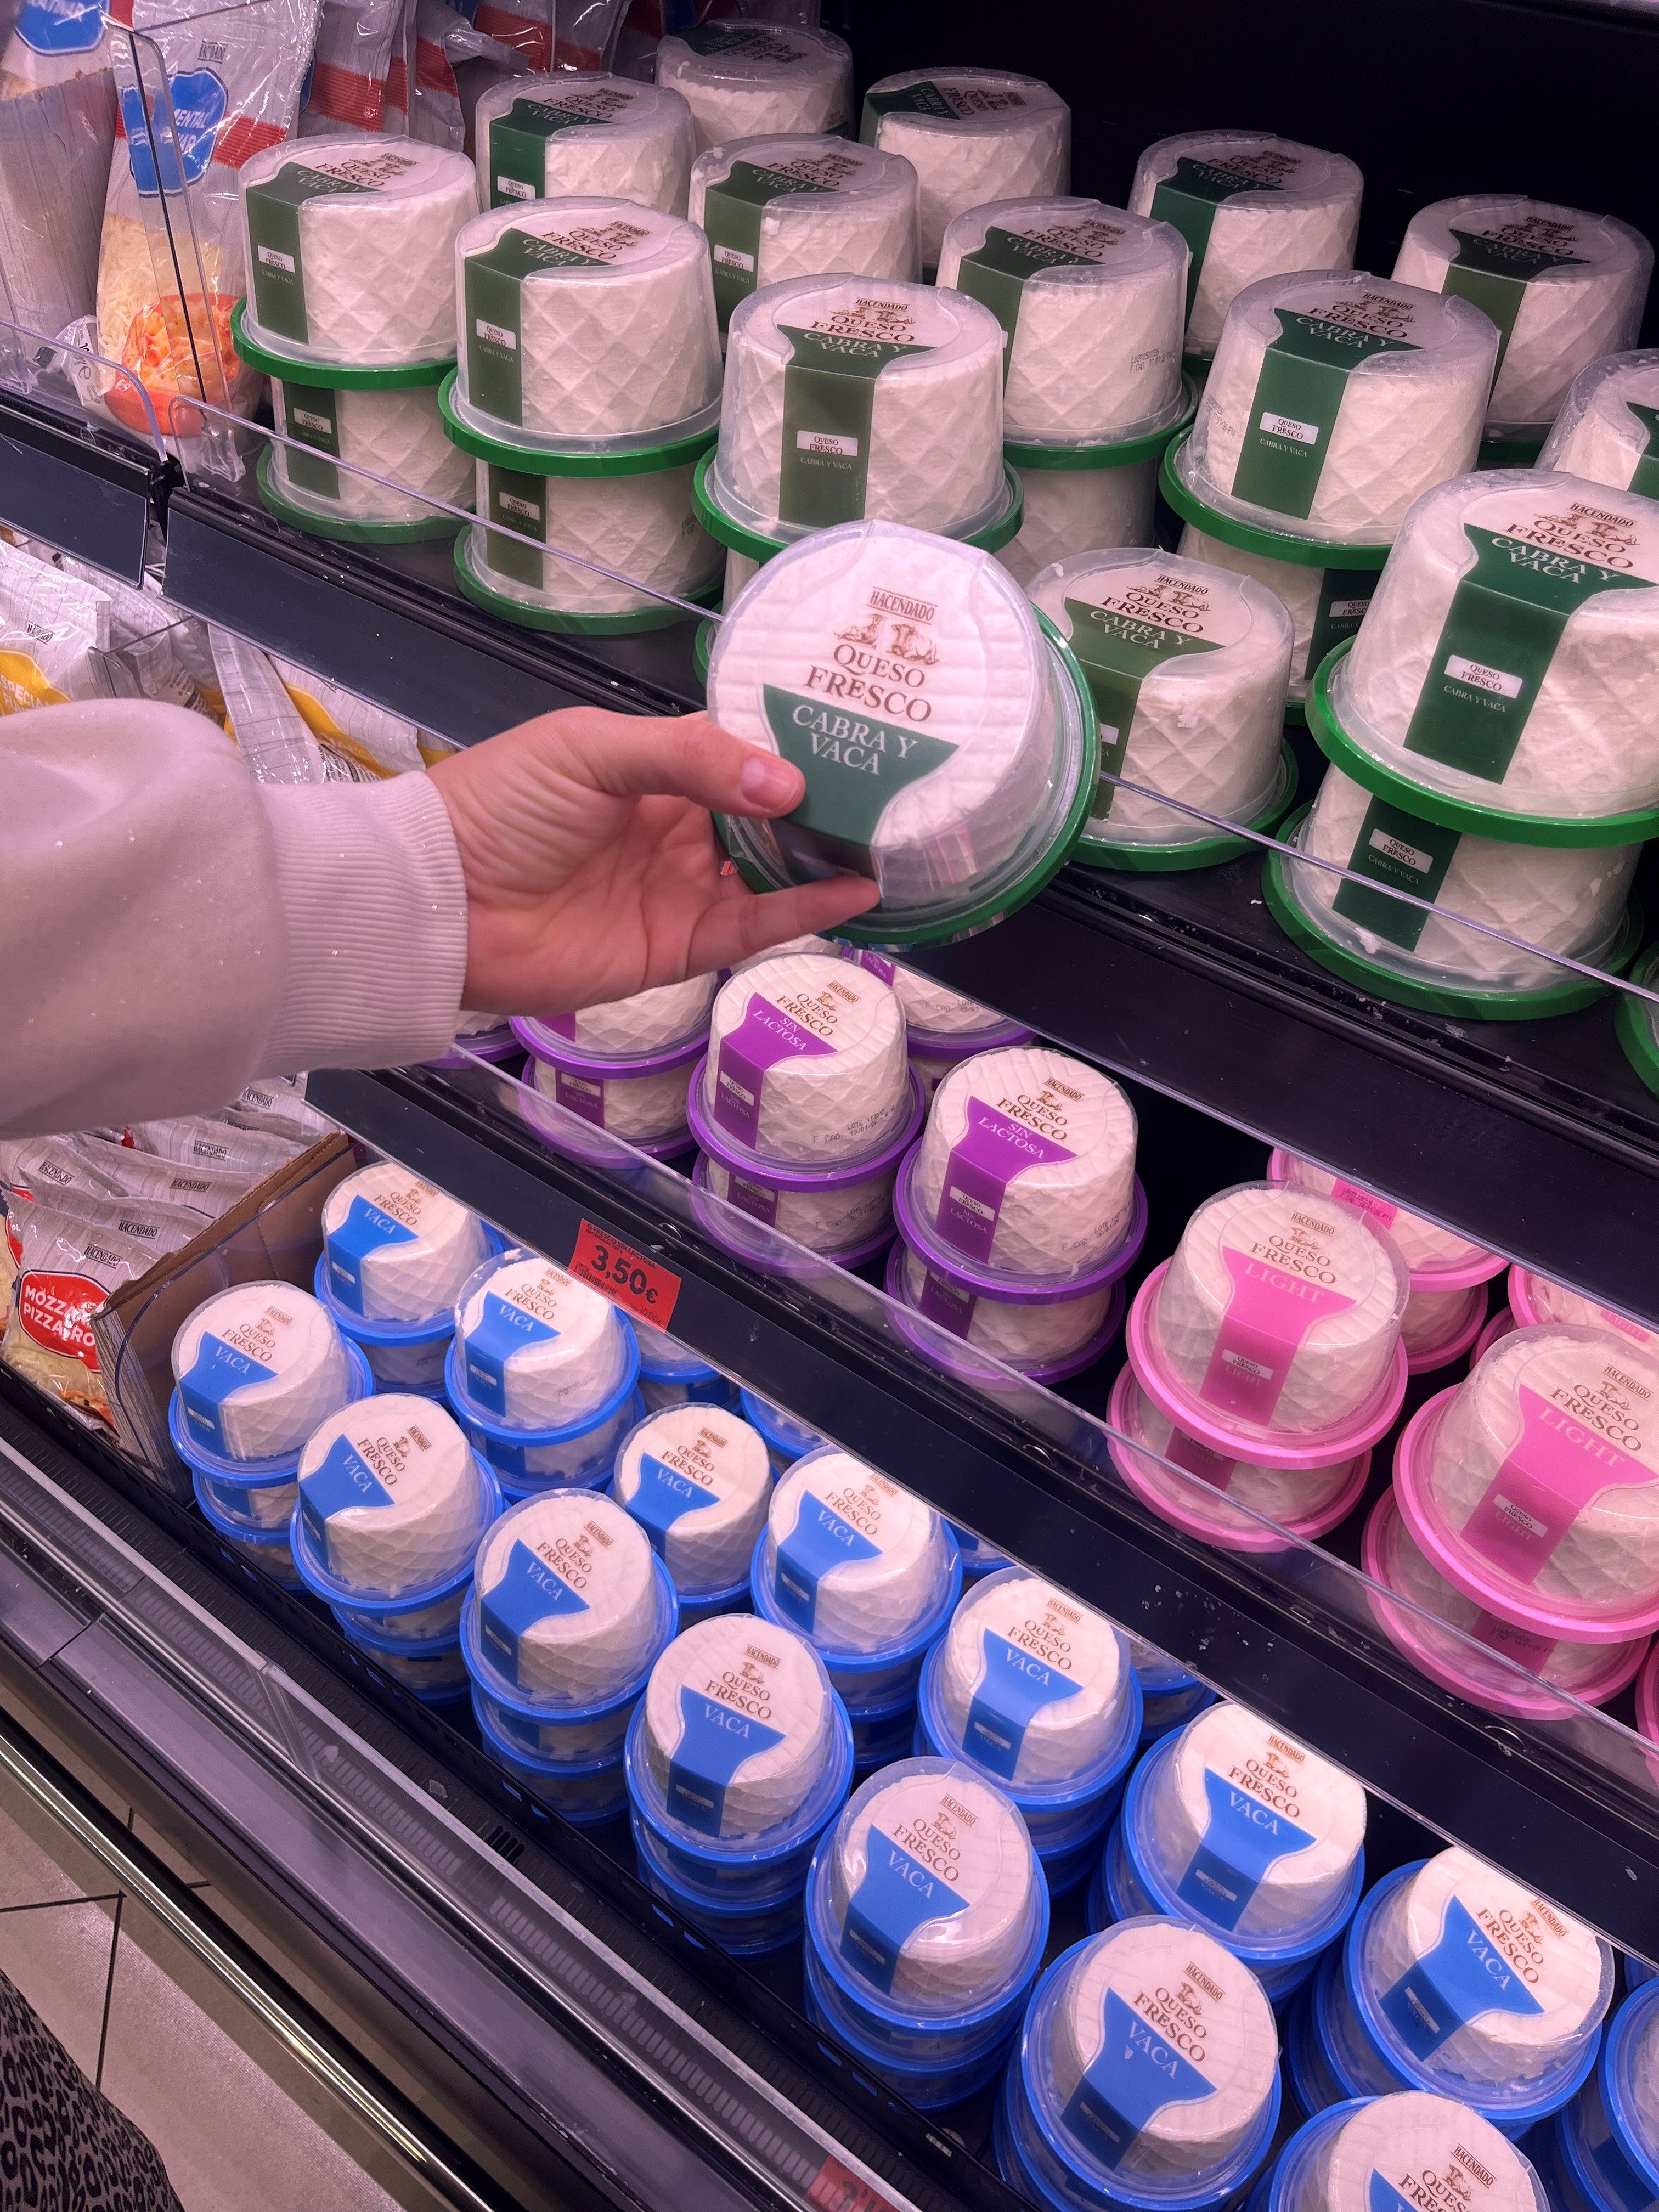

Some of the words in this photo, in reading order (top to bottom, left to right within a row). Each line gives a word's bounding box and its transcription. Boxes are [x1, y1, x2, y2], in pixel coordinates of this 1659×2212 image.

[527, 104, 578, 121] CABRA
[542, 98, 612, 118] FRESCO
[565, 95, 615, 112] QUESO
[532, 110, 571, 125] VACA
[296, 169, 347, 190] CABRA
[315, 163, 385, 188] FRESCO
[341, 161, 391, 180] QUESO
[752, 168, 807, 189] CABRA
[766, 162, 840, 187] FRESCO
[791, 160, 843, 179] QUESO
[1192, 165, 1251, 187] CABRA
[1198, 171, 1244, 189] VACA
[1206, 158, 1283, 183] FRESCO
[1229, 158, 1283, 177] QUESO
[297, 177, 337, 194] VACA
[755, 177, 798, 193] VACA
[522, 238, 578, 262] CABRA
[540, 232, 616, 259] FRESCO
[568, 230, 623, 251] QUESO
[1006, 236, 1066, 261] CABRA
[1022, 229, 1103, 258] FRESCO
[1046, 228, 1105, 249] QUESO
[1481, 229, 1574, 255] FRESCO
[1500, 227, 1568, 247] QUESO
[522, 247, 568, 266] VACA
[1011, 245, 1058, 264] VACA
[856, 298, 907, 311] HACENDADO
[1363, 293, 1414, 310] HACENDADO
[831, 315, 906, 332] QUESO
[1308, 307, 1407, 338] FRESCO
[1332, 304, 1403, 328] QUESO
[484, 333, 506, 346] FRESCO
[487, 326, 503, 337] QUESO
[803, 332, 882, 351] CABRA
[891, 345, 908, 353] Y
[811, 321, 915, 342] FRESCO
[1296, 317, 1369, 342] CABRA
[1308, 327, 1363, 348] VACA
[819, 343, 879, 357] VACA
[1272, 426, 1304, 439] FRESCO
[1278, 418, 1301, 431] QUESO
[809, 443, 843, 455] FRESCO
[814, 436, 839, 446] QUESO
[1570, 503, 1634, 527] HACENDADO
[1504, 523, 1633, 568] FRESCO
[1533, 520, 1626, 553] QUESO
[1491, 538, 1587, 574] CABRA
[1600, 570, 1622, 581] Y
[1510, 552, 1581, 583] VACA
[1157, 575, 1209, 595] HACENDADO
[870, 589, 935, 622] HACENDADO
[1101, 596, 1204, 633] FRESCO
[1126, 591, 1199, 619] QUESO
[1090, 610, 1166, 641] CABRA
[1175, 636, 1193, 646] Y
[1102, 624, 1160, 650] VACA
[833, 644, 925, 688] QUESO
[1470, 664, 1500, 680] QUESO
[804, 665, 931, 723] FRESCO
[1461, 672, 1502, 691] FRESCO
[1444, 685, 1472, 702] CABRA
[1482, 698, 1506, 713] VACA
[793, 704, 886, 753] CABRA
[897, 737, 919, 759] Y
[810, 733, 879, 775] VACA
[1383, 844, 1416, 867] FRESCO
[1390, 838, 1414, 856] QUESO
[828, 980, 860, 1003] HACENDADO
[775, 995, 833, 1037] FRESCO
[796, 993, 838, 1024] QUESO
[752, 1009, 809, 1052] LACTOSA
[780, 1016, 801, 1032] SIN
[1044, 1077, 1084, 1101] HACENDADO
[995, 1098, 1067, 1142] FRESCO
[1017, 1094, 1068, 1126] QUESO
[978, 1116, 1046, 1159] LACTOSA
[1007, 1122, 1032, 1139] SIN
[194, 1141, 227, 1159] HACENDADO
[38, 1161, 74, 1184] HACENDADO
[171, 1179, 211, 1192] HACENDADO
[373, 1194, 417, 1226] FRESCO
[390, 1191, 421, 1215] QUESO
[958, 1197, 984, 1215] FRESCO
[962, 1193, 981, 1208] QUESO
[120, 1221, 159, 1238] HACENDADO
[364, 1208, 397, 1234] VACA
[1291, 1212, 1336, 1235] HACENDADO
[86, 1244, 122, 1267] HACENDADO
[628, 1249, 656, 1269] LACTOSA
[1250, 1242, 1336, 1285] FRESCO
[1268, 1235, 1331, 1267] QUESO
[521, 1283, 557, 1308] QUESO
[1243, 1262, 1326, 1305] LIGHT
[505, 1288, 554, 1320] FRESCO
[24, 1302, 63, 1335] PIZZA
[499, 1305, 534, 1332] VACA
[221, 1328, 272, 1362] FRESCO
[240, 1323, 276, 1348] QUESO
[215, 1346, 251, 1374] VACA
[1232, 1358, 1260, 1375] FRESCO
[1237, 1356, 1258, 1368] QUESO
[1604, 1365, 1651, 1401] HACENDADO
[1550, 1387, 1641, 1453] FRESCO
[1573, 1384, 1639, 1432] QUESO
[1537, 1404, 1624, 1468] LIGHT
[357, 1438, 397, 1486] FRESCO
[376, 1437, 405, 1471] QUESO
[677, 1445, 714, 1471] QUESO
[342, 1455, 373, 1493] VACA
[661, 1451, 713, 1486] FRESCO
[657, 1468, 693, 1498] VACA
[825, 1491, 877, 1536] FRESCO
[843, 1487, 881, 1521] QUESO
[1510, 1504, 1532, 1522] QUESO
[817, 1509, 855, 1547] VACA
[1504, 1506, 1533, 1530] FRESCO
[536, 1541, 587, 1589] FRESCO
[556, 1538, 592, 1573] QUESO
[526, 1561, 563, 1601] VACA
[1047, 1598, 1082, 1622] HACENDADO
[1007, 1626, 1072, 1670] FRESCO
[1024, 1620, 1071, 1652] QUESO
[745, 1646, 781, 1668] HACENDADO
[1005, 1647, 1051, 1686] VACA
[723, 1671, 771, 1701] QUESO
[705, 1680, 772, 1719] FRESCO
[703, 1703, 749, 1739] VACA
[1268, 1734, 1305, 1764] HACENDADO
[1228, 1765, 1300, 1818] FRESCO
[1246, 1759, 1297, 1798] QUESO
[941, 1795, 977, 1825] HACENDADO
[1229, 1791, 1280, 1836] VACA
[892, 1824, 959, 1881] FRESCO
[913, 1819, 961, 1860] QUESO
[888, 1850, 934, 1899] VACA
[1534, 1899, 1566, 1938] HACENDADO
[1476, 1907, 1539, 1984] FRESCO
[1498, 1909, 1544, 1966] QUESO
[1466, 1929, 1510, 1991] VACA
[1186, 1965, 1223, 2000] HACENDADO
[1155, 1987, 1207, 2039] QUESO
[1133, 1991, 1205, 2062] FRESCO
[1128, 2020, 1179, 2080] VACA
[1454, 2146, 1494, 2186] HACENDADO
